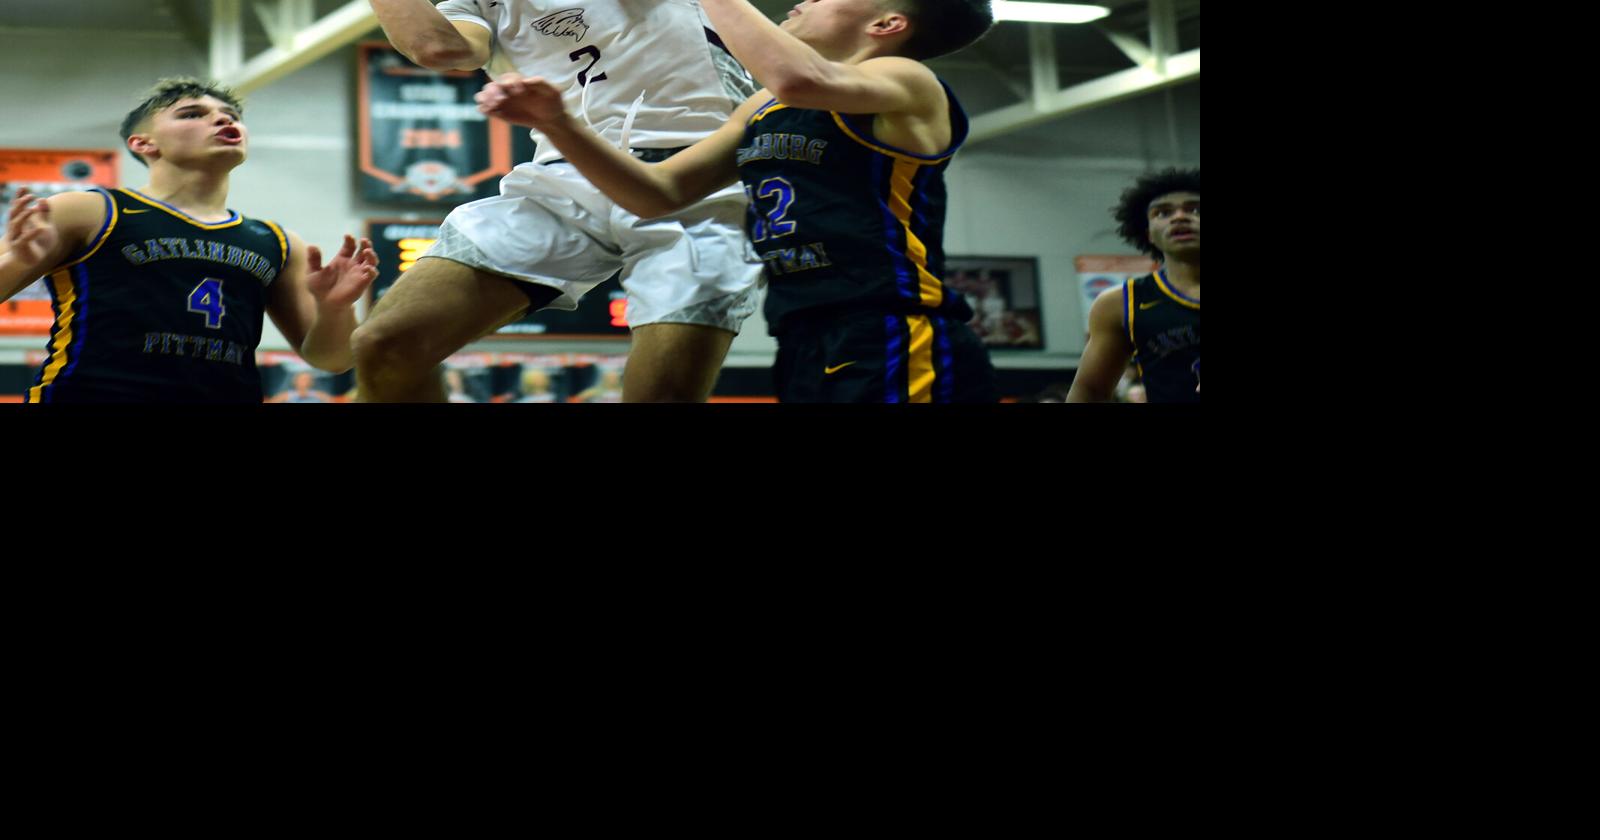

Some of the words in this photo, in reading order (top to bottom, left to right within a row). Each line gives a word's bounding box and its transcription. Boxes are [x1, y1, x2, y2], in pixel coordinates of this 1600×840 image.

[569, 44, 607, 88] 2
[121, 237, 277, 287] GATLINBURG
[187, 277, 226, 329] 4
